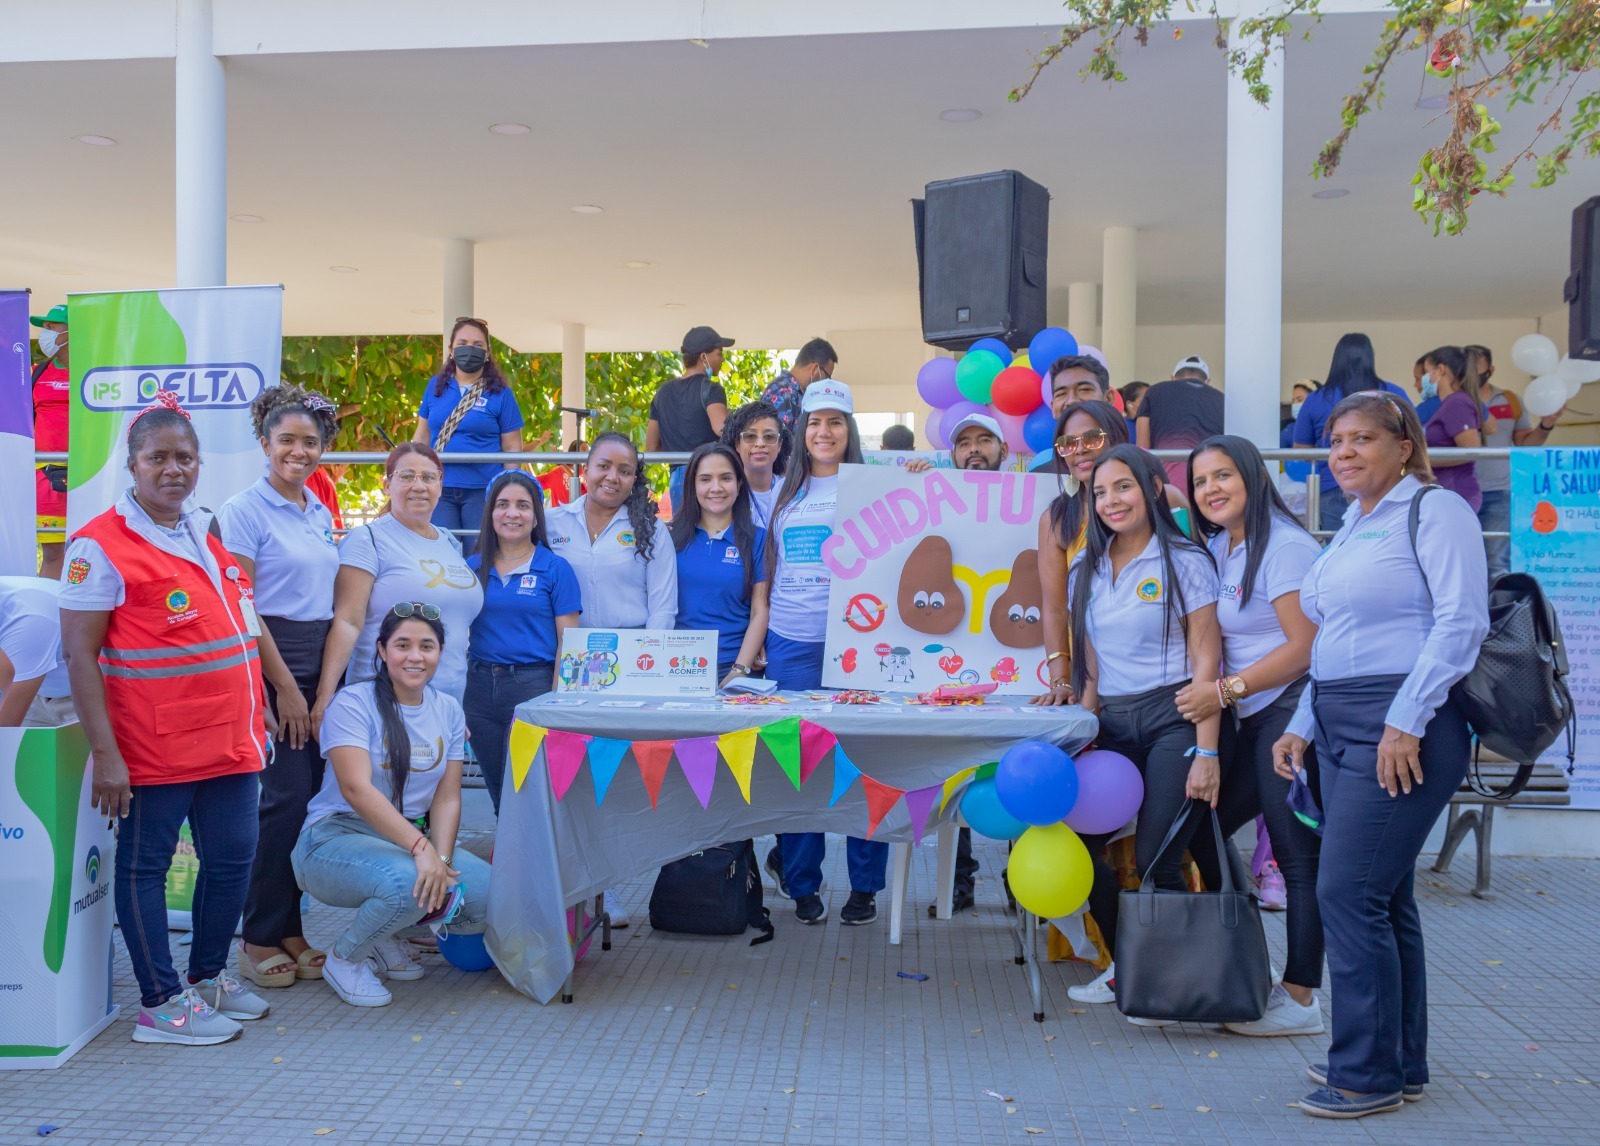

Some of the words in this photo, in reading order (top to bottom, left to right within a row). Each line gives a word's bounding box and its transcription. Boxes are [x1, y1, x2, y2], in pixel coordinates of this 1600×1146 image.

[93, 382, 121, 401] IPS
[137, 370, 247, 404] DELTA
[1545, 449, 1563, 470] TE
[1534, 473, 1551, 494] LA
[820, 471, 968, 580] CUIDA
[963, 471, 1037, 525] TU
[1565, 509, 1574, 519] 12
[74, 882, 110, 914] mutualser
